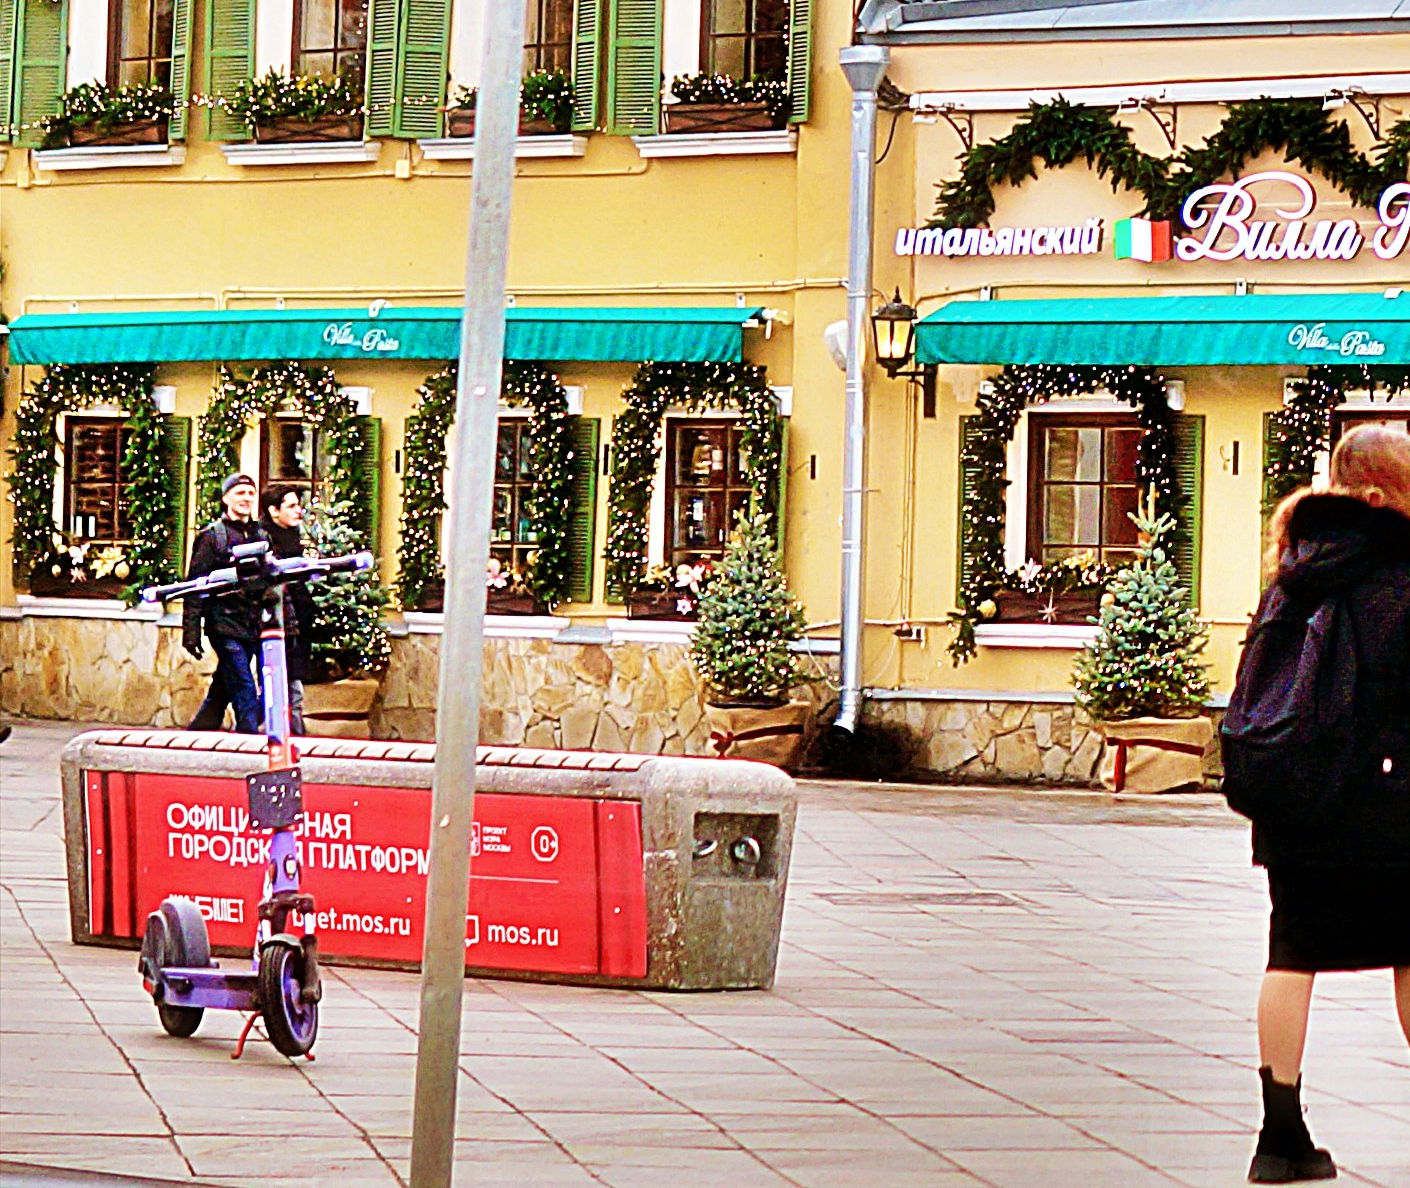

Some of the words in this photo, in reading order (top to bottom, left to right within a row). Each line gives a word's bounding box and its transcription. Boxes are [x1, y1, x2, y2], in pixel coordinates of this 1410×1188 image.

[895, 217, 1102, 257] итальянский
[1176, 171, 1364, 261] Вилла
[1288, 322, 1329, 350] Villa
[1340, 330, 1386, 356] Pasta
[166, 802, 352, 840] ОФИЦИНАЯ
[168, 832, 303, 867] ГОРОДСКЯ
[308, 842, 431, 876] ПЛАТФОРМ
[292, 907, 411, 936] bet.mos.ru
[487, 923, 559, 947] mos.ru
